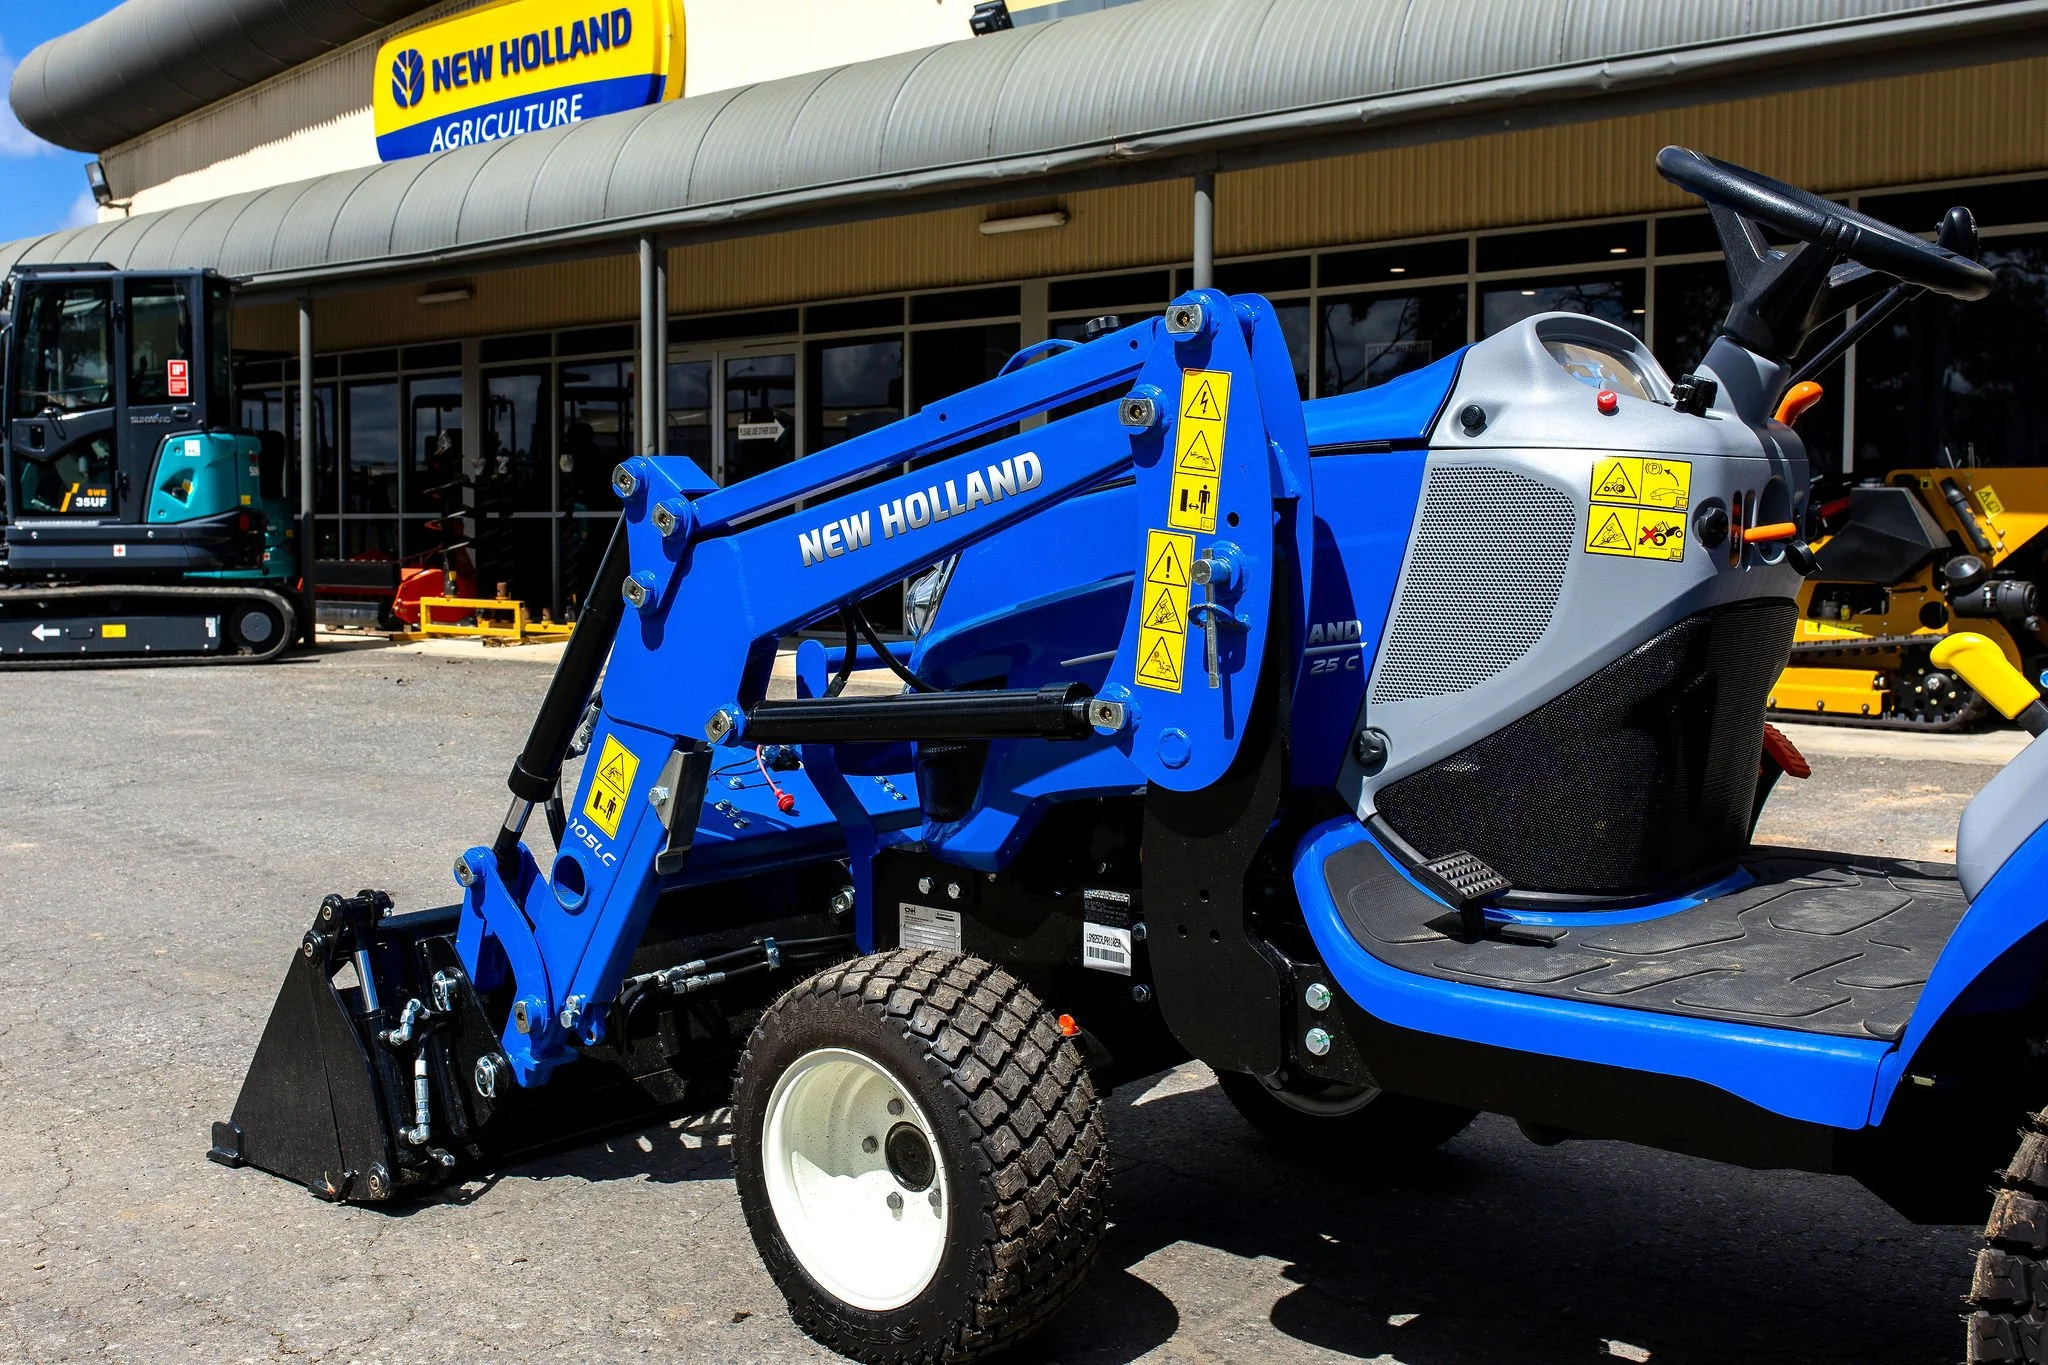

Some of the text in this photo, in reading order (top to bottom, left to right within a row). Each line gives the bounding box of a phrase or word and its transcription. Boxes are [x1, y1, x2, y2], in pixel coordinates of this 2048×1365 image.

[432, 8, 632, 92] NEW HOLLAND
[430, 93, 583, 152] AGRICULTURE
[75, 497, 107, 508] 35UF
[798, 451, 1043, 567] NEW HOLLAND
[1310, 657, 1340, 676] 25
[569, 817, 617, 868] 105LC
